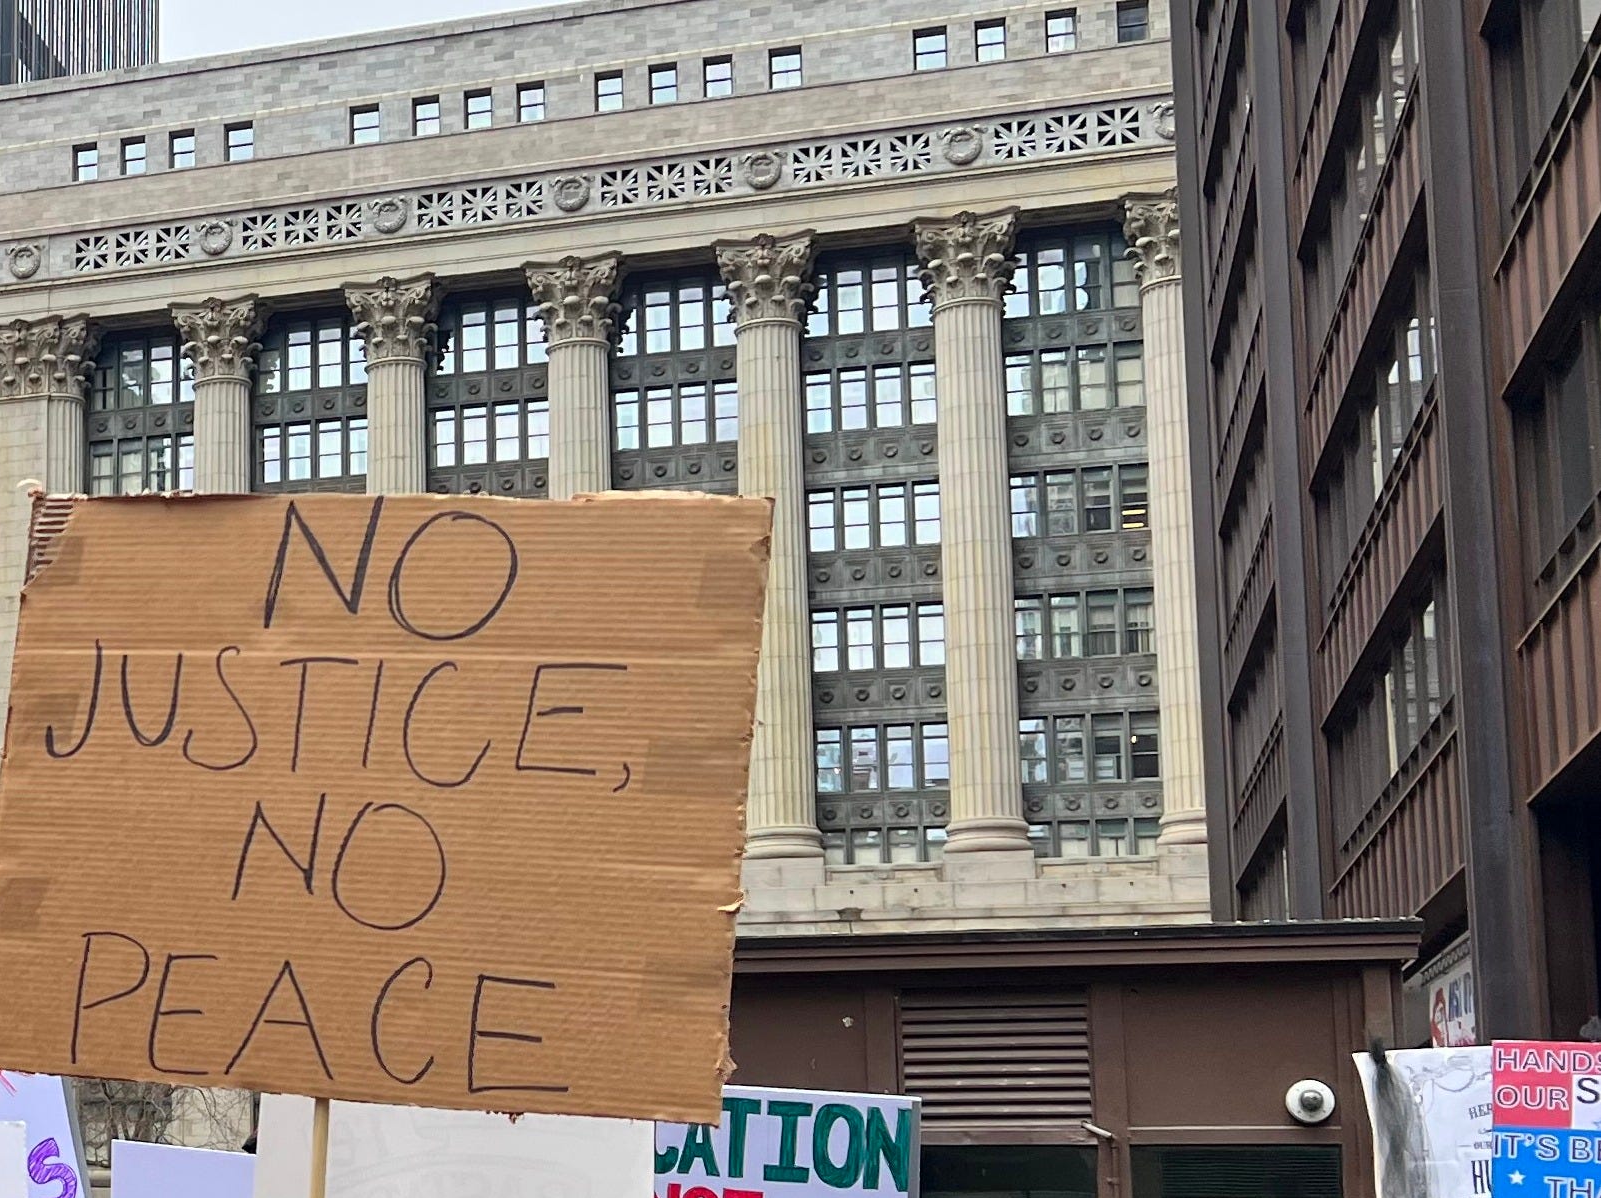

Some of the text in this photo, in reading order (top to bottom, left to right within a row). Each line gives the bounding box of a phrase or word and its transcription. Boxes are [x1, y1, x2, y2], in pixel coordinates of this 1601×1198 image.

[263, 496, 518, 640] NO
[45, 639, 631, 792] JUSTICE,
[232, 793, 446, 930] NO
[72, 931, 569, 1093] PEACE
[1495, 1084, 1570, 1110] OUR
